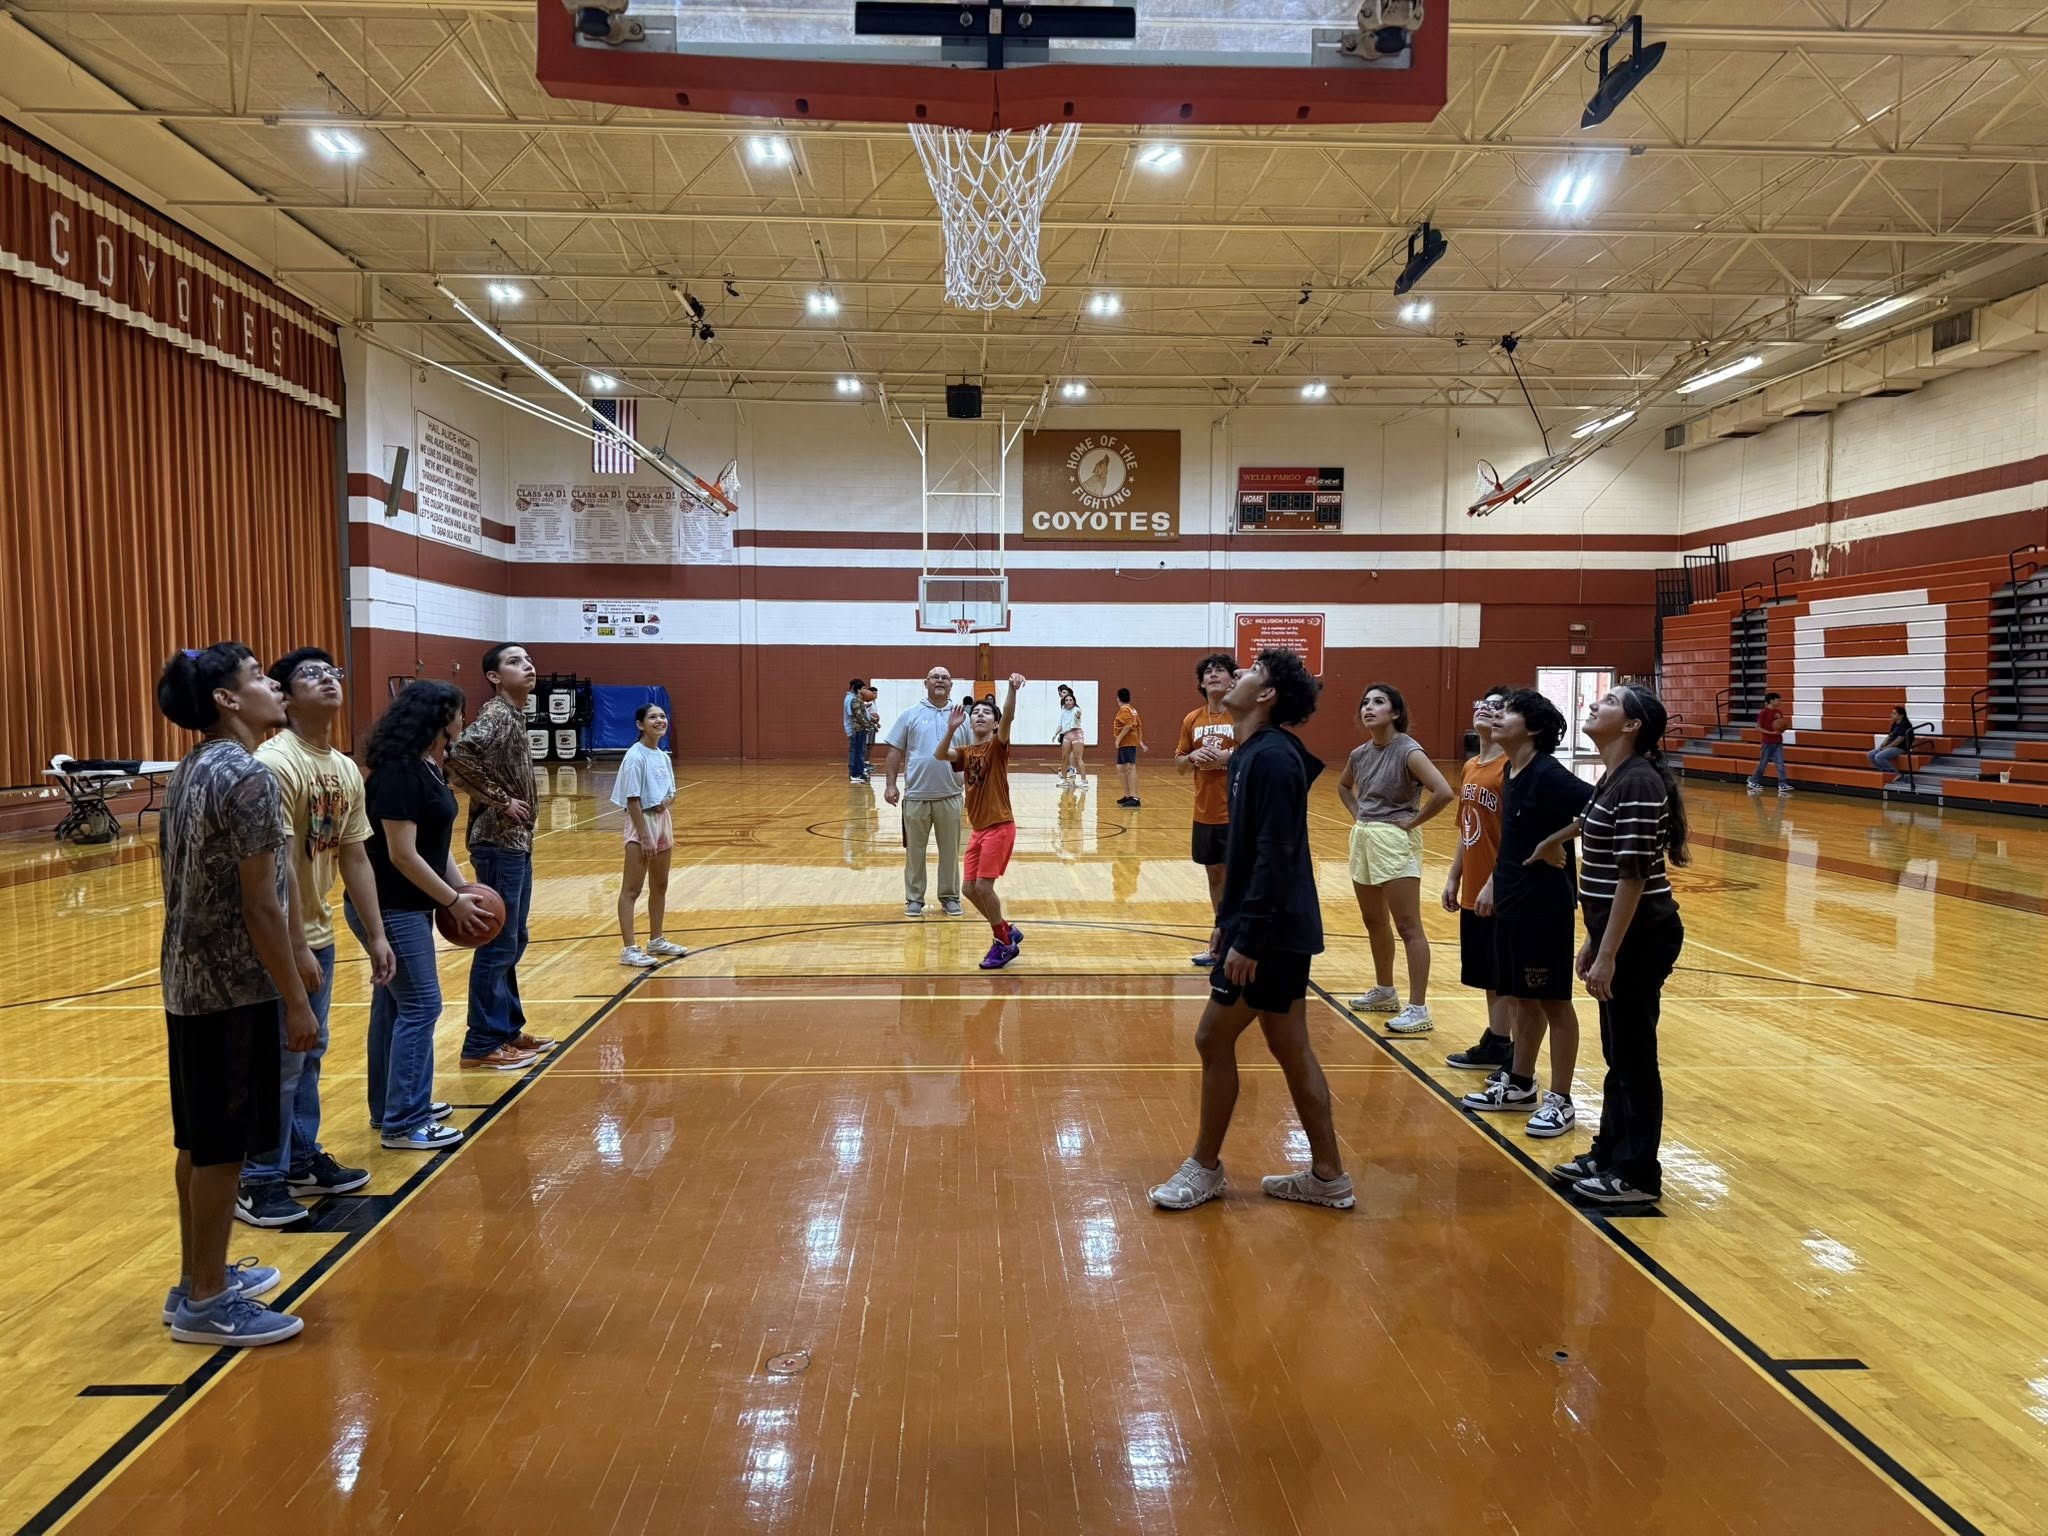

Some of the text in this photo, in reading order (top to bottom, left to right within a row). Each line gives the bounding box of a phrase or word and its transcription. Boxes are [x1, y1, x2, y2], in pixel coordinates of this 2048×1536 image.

[50, 211, 282, 367] COYOTES
[1067, 435, 1138, 470] HOME OF THE
[517, 489, 541, 497] CLASS
[572, 490, 596, 498] CLASS
[626, 490, 651, 499] CLASS
[1072, 486, 1131, 509] FIGHTING
[1242, 495, 1264, 503] HOME
[1032, 511, 1170, 531] COYOTES
[1478, 787, 1497, 812] HS
